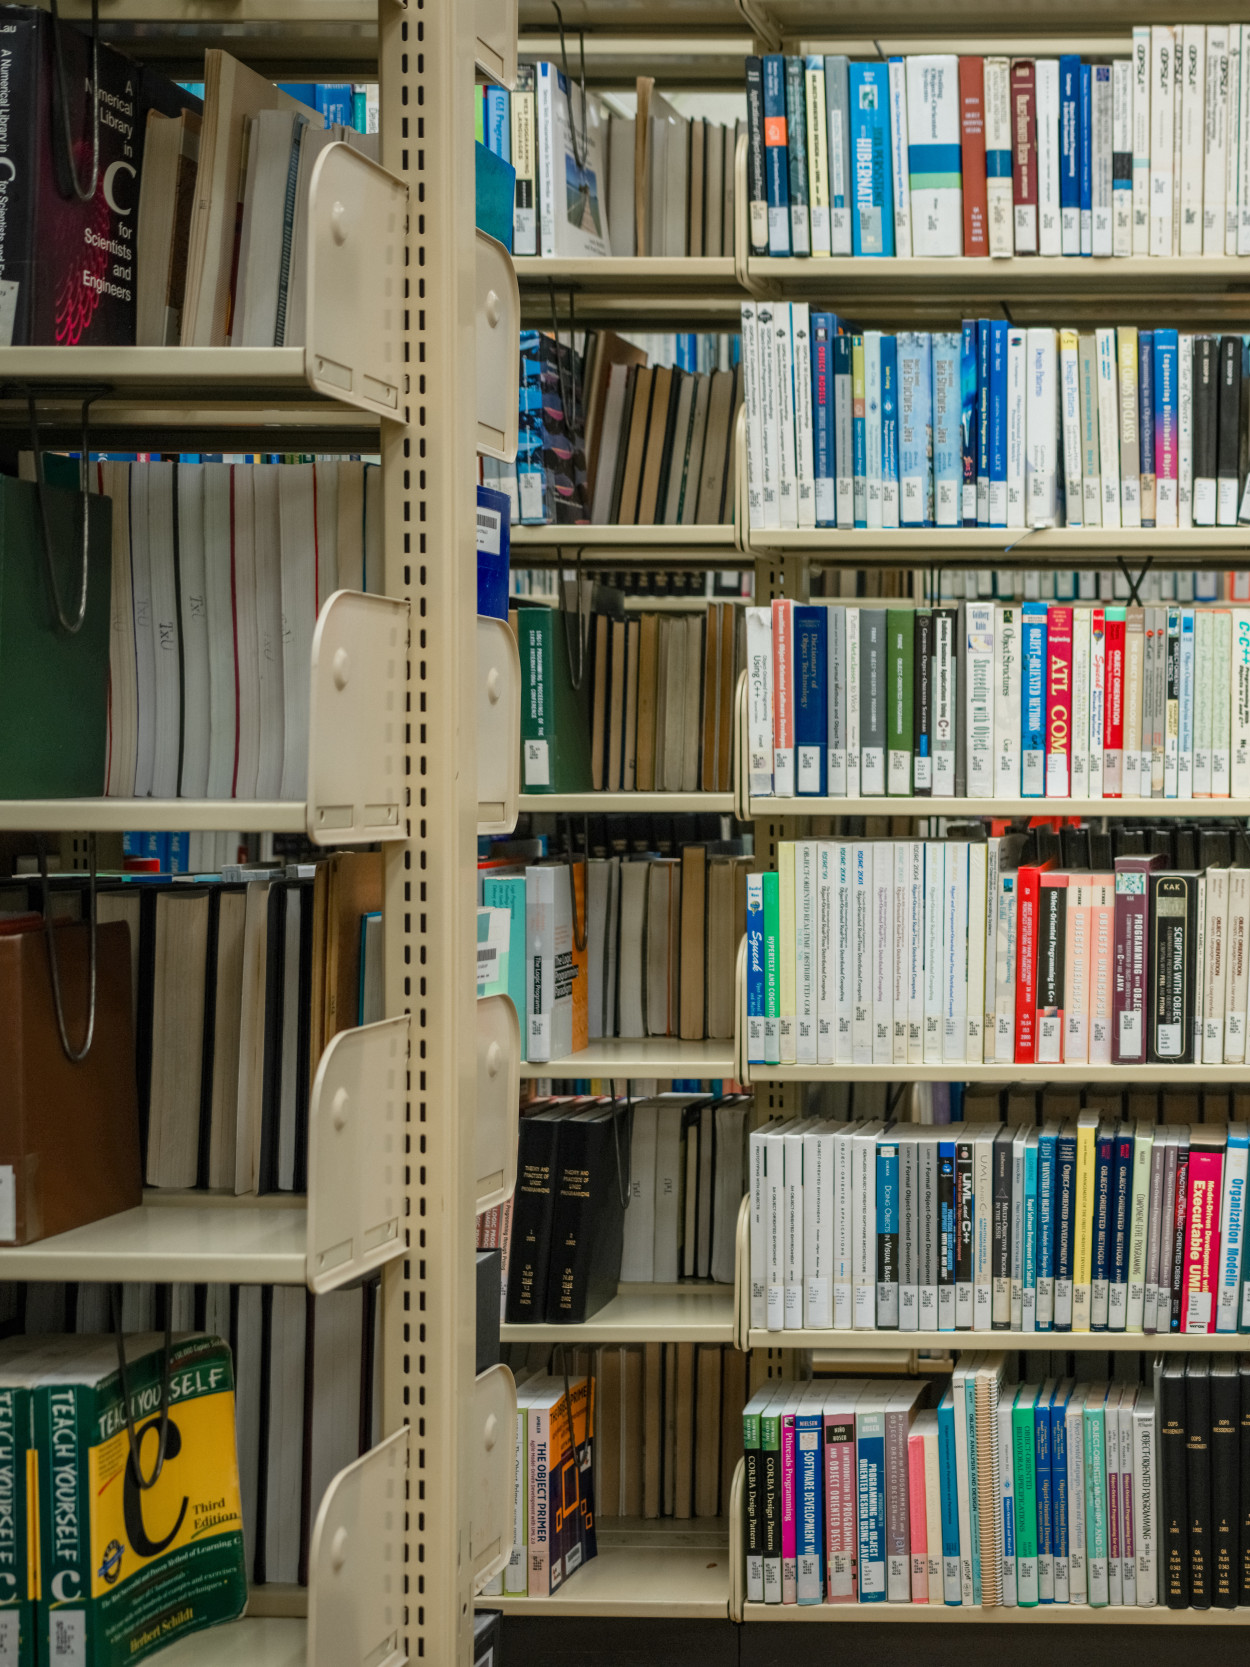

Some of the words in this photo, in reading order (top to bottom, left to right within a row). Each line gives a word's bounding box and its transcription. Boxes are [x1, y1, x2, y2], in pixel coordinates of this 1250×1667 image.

[0, 49, 12, 57] A
[0, 59, 12, 107] Numerical
[84, 77, 133, 117] Nmerical
[125, 80, 133, 96] A
[0, 109, 11, 142] Library
[100, 107, 133, 140] Library
[124, 141, 133, 158] in
[103, 161, 137, 216] C
[856, 138, 873, 211] HIBERNATE
[84, 227, 132, 261] Scientists
[118, 221, 133, 239] for
[83, 269, 132, 301] Engineers
[113, 263, 132, 281] and
[817, 346, 826, 373] OBJECT
[818, 375, 827, 405] MODELS
[1162, 353, 1172, 403] Engineering
[937, 427, 949, 444] Java
[1162, 405, 1172, 451] Distributed
[848, 615, 858, 640] Putting
[1000, 628, 1014, 654] Object
[800, 633, 810, 664] Object
[809, 633, 819, 679] Dictionary
[850, 641, 858, 684] Metaclasses
[1112, 650, 1121, 677] OBJECT
[751, 655, 762, 678] Using
[970, 659, 991, 704] Succeeding
[1001, 655, 1013, 697] Structures
[1051, 655, 1068, 696] ATL
[1093, 654, 1104, 689] Squeak
[753, 680, 763, 698] C++
[798, 666, 811, 709] Technology
[810, 680, 819, 689] of
[850, 685, 858, 693] to
[850, 695, 858, 713] Work
[972, 706, 991, 723] with
[1112, 678, 1121, 726] ORIENTATION
[1051, 705, 1068, 754] COM
[1047, 891, 1058, 939] Object-Oriented
[750, 930, 763, 973] Squeak
[767, 936, 776, 973] HYPERTEXT
[1046, 940, 1056, 982] Programming
[1172, 926, 1183, 970] SCRIPTING
[768, 973, 776, 987] AND
[1048, 991, 1056, 1003] C++
[1172, 971, 1182, 993] WITH
[884, 1185, 892, 1207] DOING
[962, 1172, 972, 1204] UML
[1204, 1180, 1215, 1229] Model-Driven
[884, 1207, 892, 1233] OBJECTS
[904, 1189, 912, 1240] Object-Oriented
[924, 1190, 932, 1241] Object-Oriented
[1189, 1180, 1206, 1260] Executable
[1227, 1178, 1245, 1244] Organization
[962, 1220, 972, 1244] C++
[884, 1242, 892, 1264] VISUAL
[904, 1241, 912, 1284] Development
[923, 1243, 932, 1285] Development
[1202, 1230, 1212, 1279] Development
[138, 1368, 224, 1414] YOUSELF
[50, 1389, 77, 1458] TEACH
[968, 1413, 976, 1440] OBJECT
[537, 1442, 547, 1462] THE
[784, 1432, 793, 1467] Pthreads
[969, 1440, 977, 1471] ANALYSIS
[1140, 1430, 1151, 1488] OBJECT-ORIENTED
[123, 1416, 189, 1558] C
[535, 1464, 547, 1500] OBJECT
[747, 1455, 757, 1489] CORBA
[766, 1457, 776, 1490] CORBA
[803, 1451, 815, 1490] SOFTWARE
[859, 1458, 868, 1492] ORIENTED
[747, 1491, 757, 1516] Design
[765, 1492, 776, 1518] Design
[782, 1468, 794, 1522] Programming
[868, 1463, 878, 1516] PROGRAMMING
[970, 1488, 978, 1512] DESIGN
[53, 1463, 77, 1562] YOURSELF
[192, 1498, 225, 1516] Third
[194, 1512, 238, 1530] Edition
[537, 1503, 547, 1542] PRIMER
[803, 1491, 815, 1543] DEVELOPMENT
[859, 1493, 868, 1522] DESIGN
[1141, 1488, 1151, 1540] PROGRAMMING
[748, 1519, 758, 1549] Patterns
[767, 1521, 776, 1551] Patterns
[860, 1522, 869, 1542] USING
[869, 1531, 878, 1557] OBJECT
[860, 1543, 869, 1564] JAVA
[51, 1569, 81, 1603] C
[130, 1625, 161, 1654] Herbert
[161, 1607, 194, 1630] Schildt
